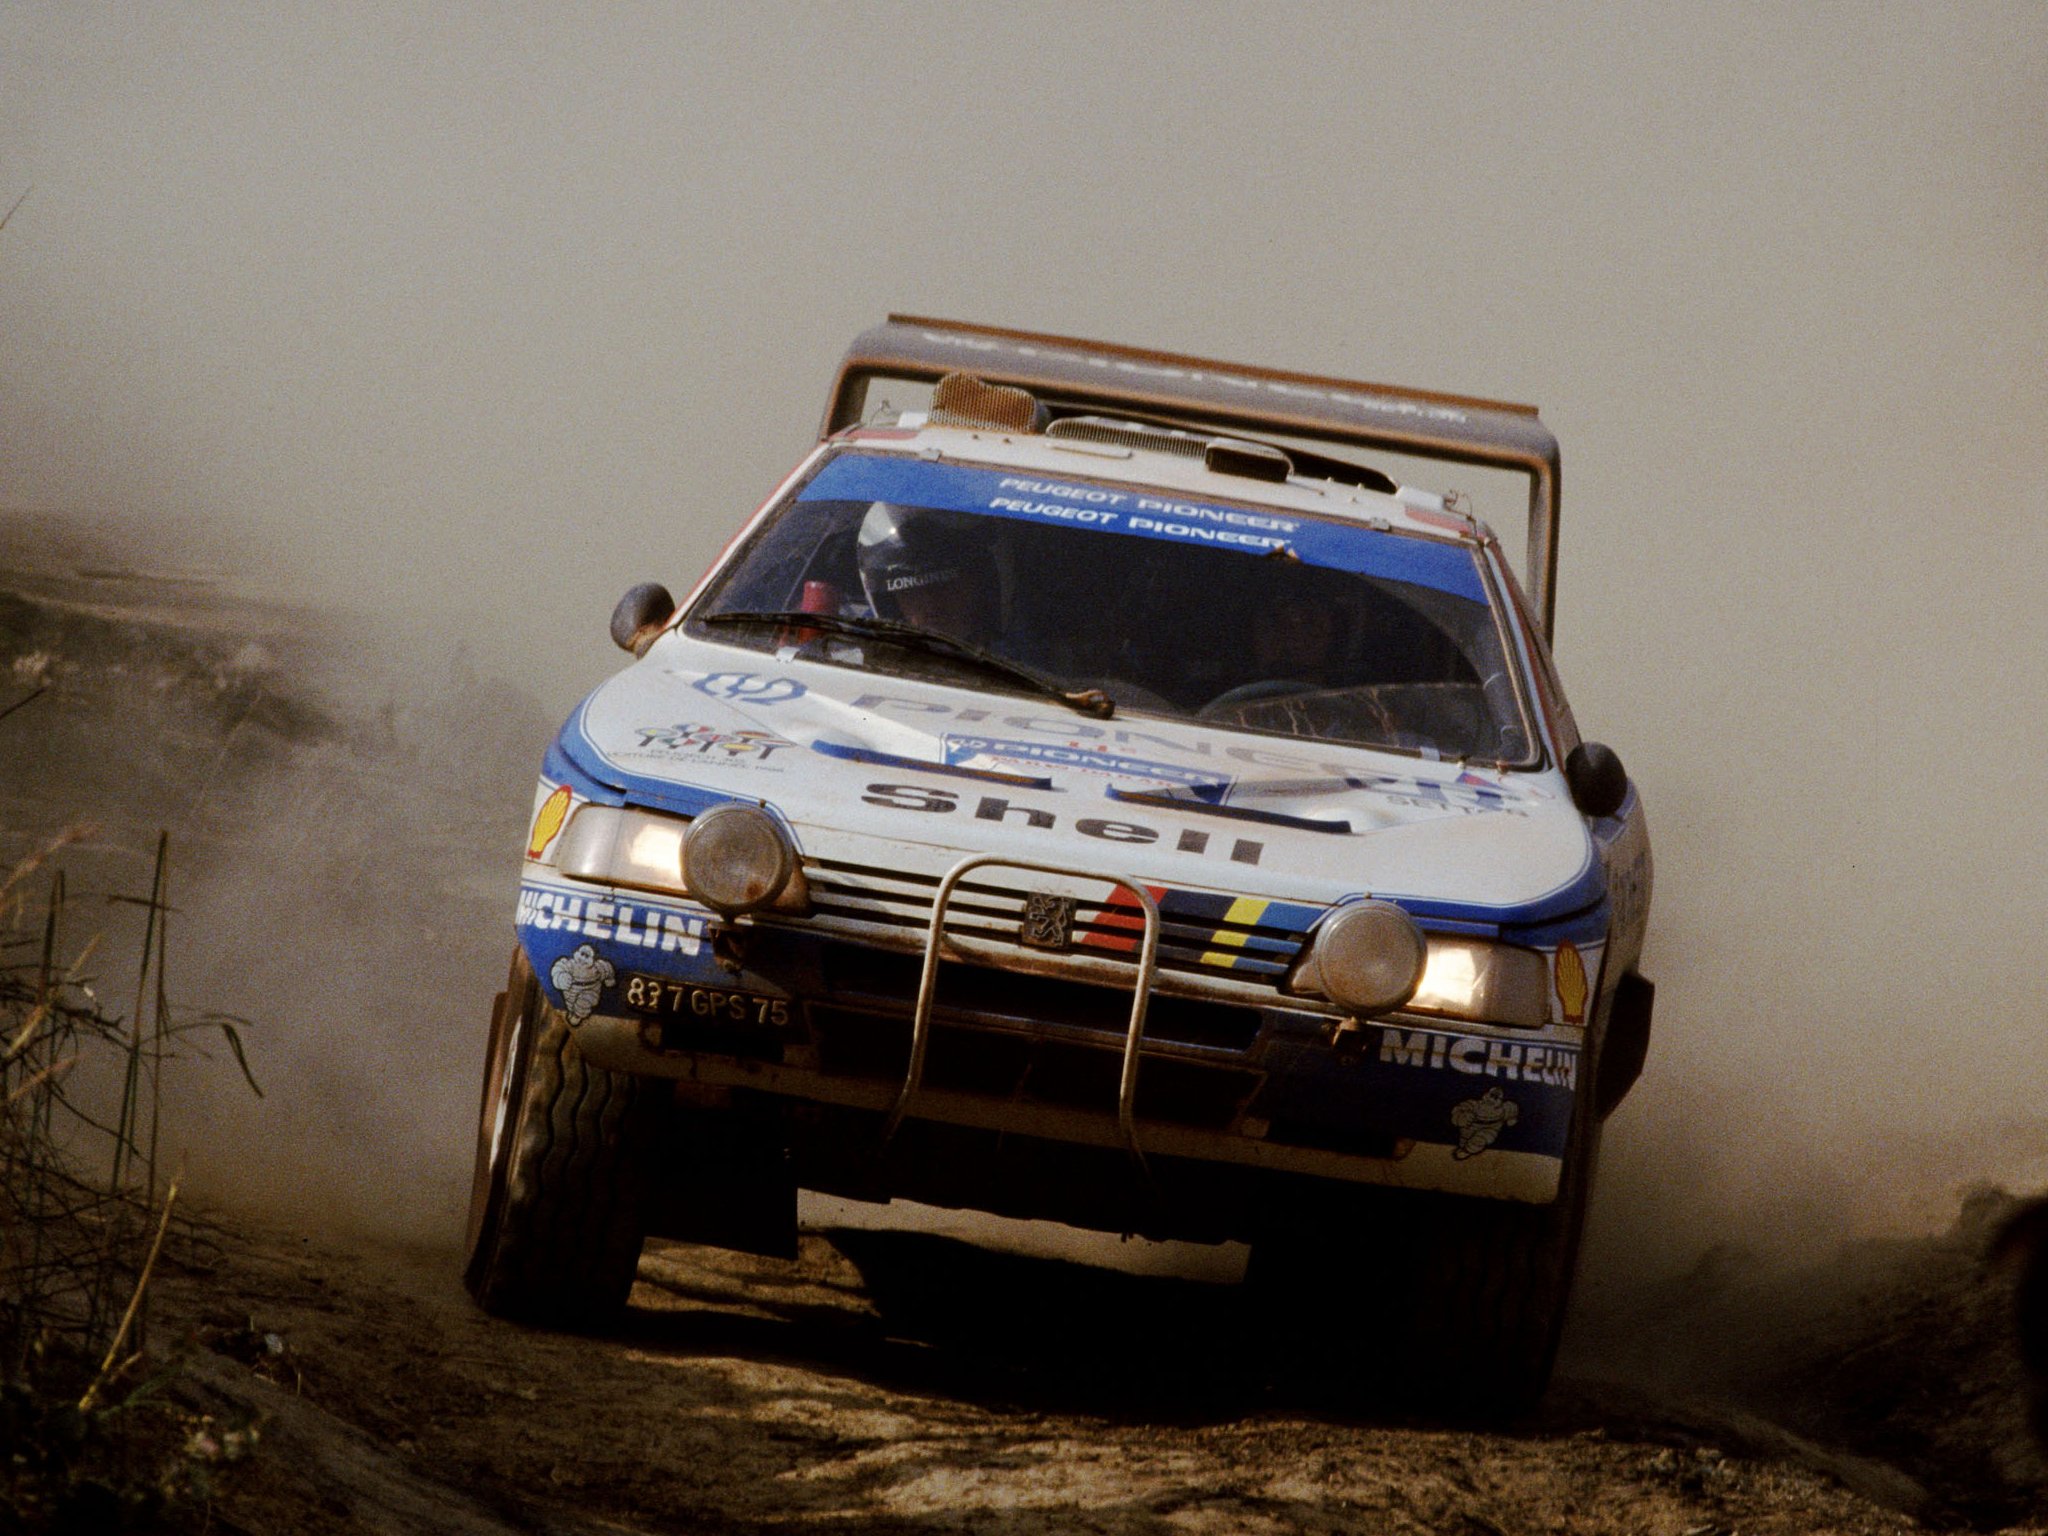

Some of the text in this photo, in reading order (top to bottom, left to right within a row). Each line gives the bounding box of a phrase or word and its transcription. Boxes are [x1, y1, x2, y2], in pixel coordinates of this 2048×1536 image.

[989, 496, 1292, 548] PEUGEOT PIONEER
[999, 478, 1299, 532] PEUGEOT PIONEER
[861, 783, 1264, 866] Shell
[514, 890, 704, 957] MICHELIN
[691, 990, 745, 1020] GPS
[752, 998, 789, 1026] 75
[1379, 1028, 1577, 1092] MICHELIN
